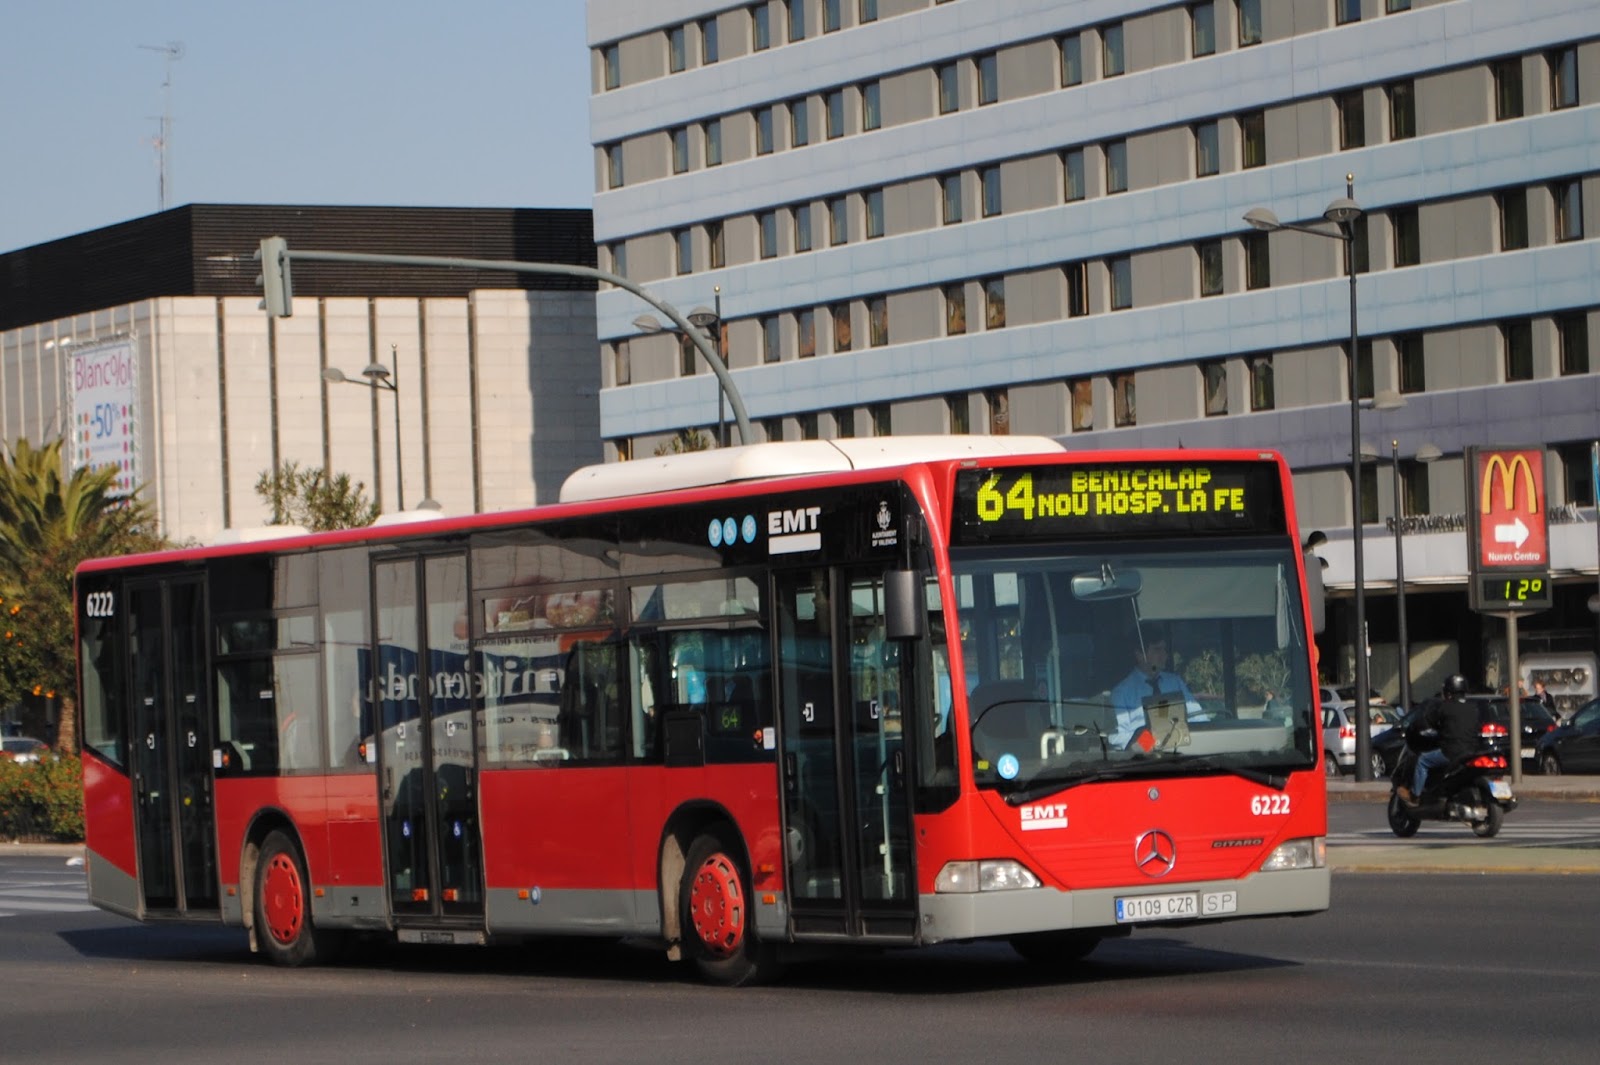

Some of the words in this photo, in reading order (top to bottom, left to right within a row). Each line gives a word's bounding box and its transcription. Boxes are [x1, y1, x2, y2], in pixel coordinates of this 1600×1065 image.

[1072, 468, 1211, 492] BENICALAP
[977, 474, 1034, 520] 64
[1038, 493, 1089, 516] NOU
[1096, 490, 1170, 515] HOSP.
[1177, 489, 1207, 512] LA
[1214, 488, 1244, 511] FE
[768, 507, 821, 535] EMT
[1488, 552, 1512, 562] Nuevo
[1514, 551, 1540, 561] Centro
[86, 591, 114, 617] 6222
[722, 707, 738, 729] 64
[1020, 804, 1068, 820] EMT
[1251, 794, 1291, 816] 6222
[1213, 839, 1262, 848] CITARO
[1127, 900, 1161, 917] 0109
[1167, 896, 1194, 913] CZR
